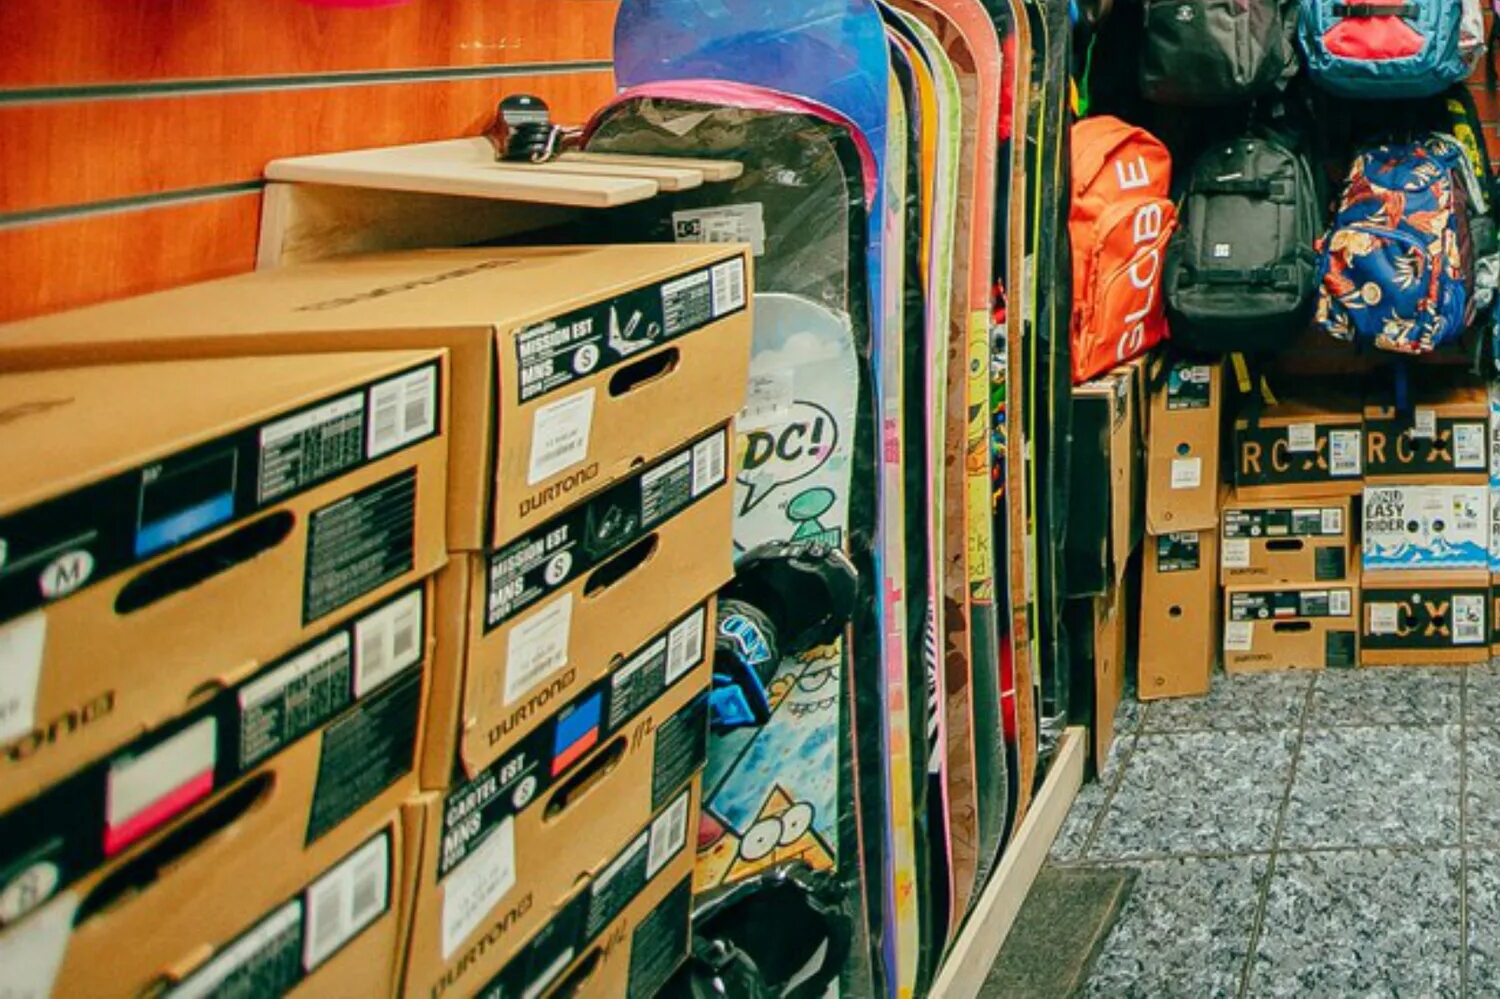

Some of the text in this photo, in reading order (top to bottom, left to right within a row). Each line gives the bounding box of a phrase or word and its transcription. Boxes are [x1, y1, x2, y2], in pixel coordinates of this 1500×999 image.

[1115, 156, 1163, 361] GLOBE
[519, 318, 594, 360] MISSION EST
[1365, 503, 1405, 520] EASY
[1366, 520, 1405, 534] RIDER
[491, 524, 570, 575] MISSION EST
[54, 560, 81, 587] M
[1363, 602, 1450, 637] CX
[447, 752, 527, 828] CARTEL EST
